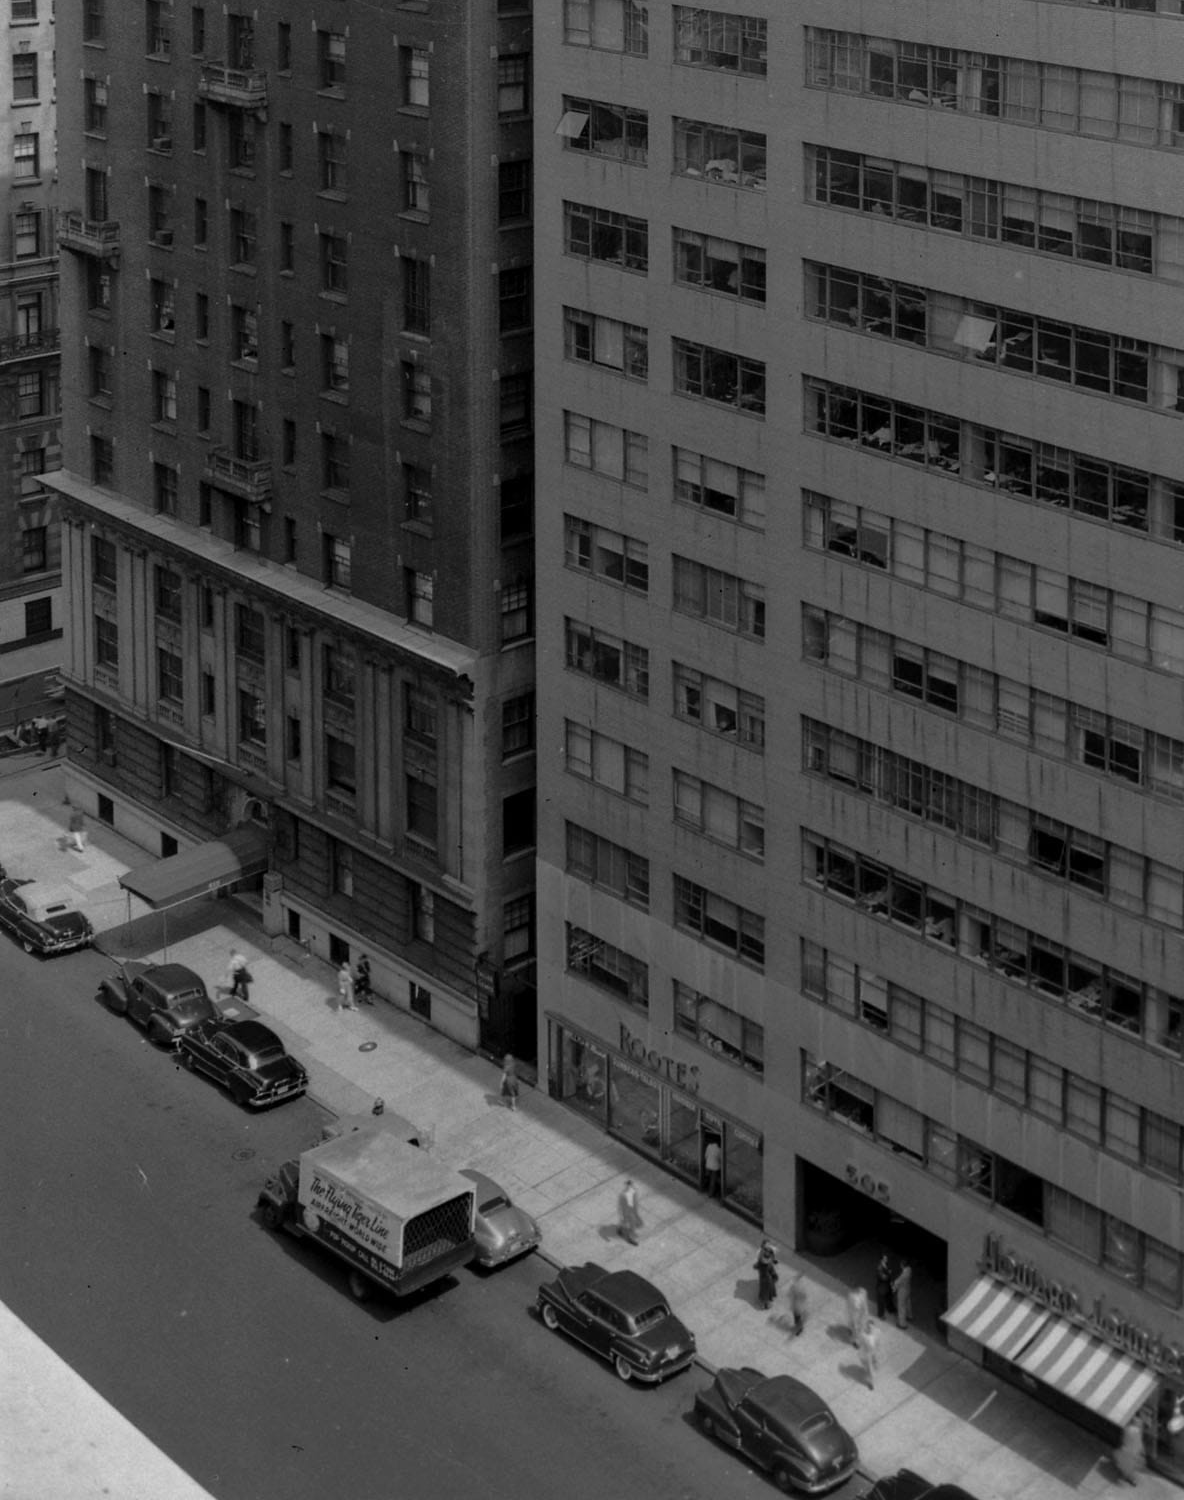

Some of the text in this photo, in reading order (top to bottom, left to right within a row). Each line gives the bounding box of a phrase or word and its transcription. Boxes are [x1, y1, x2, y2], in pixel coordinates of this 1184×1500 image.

[619, 1021, 700, 1095] ROOTES
[310, 1176, 390, 1240] The Flying Tiger Line
[349, 1223, 370, 1243] WORLD
[370, 1237, 388, 1254] WIDE
[981, 1232, 1084, 1320] HOWARD
